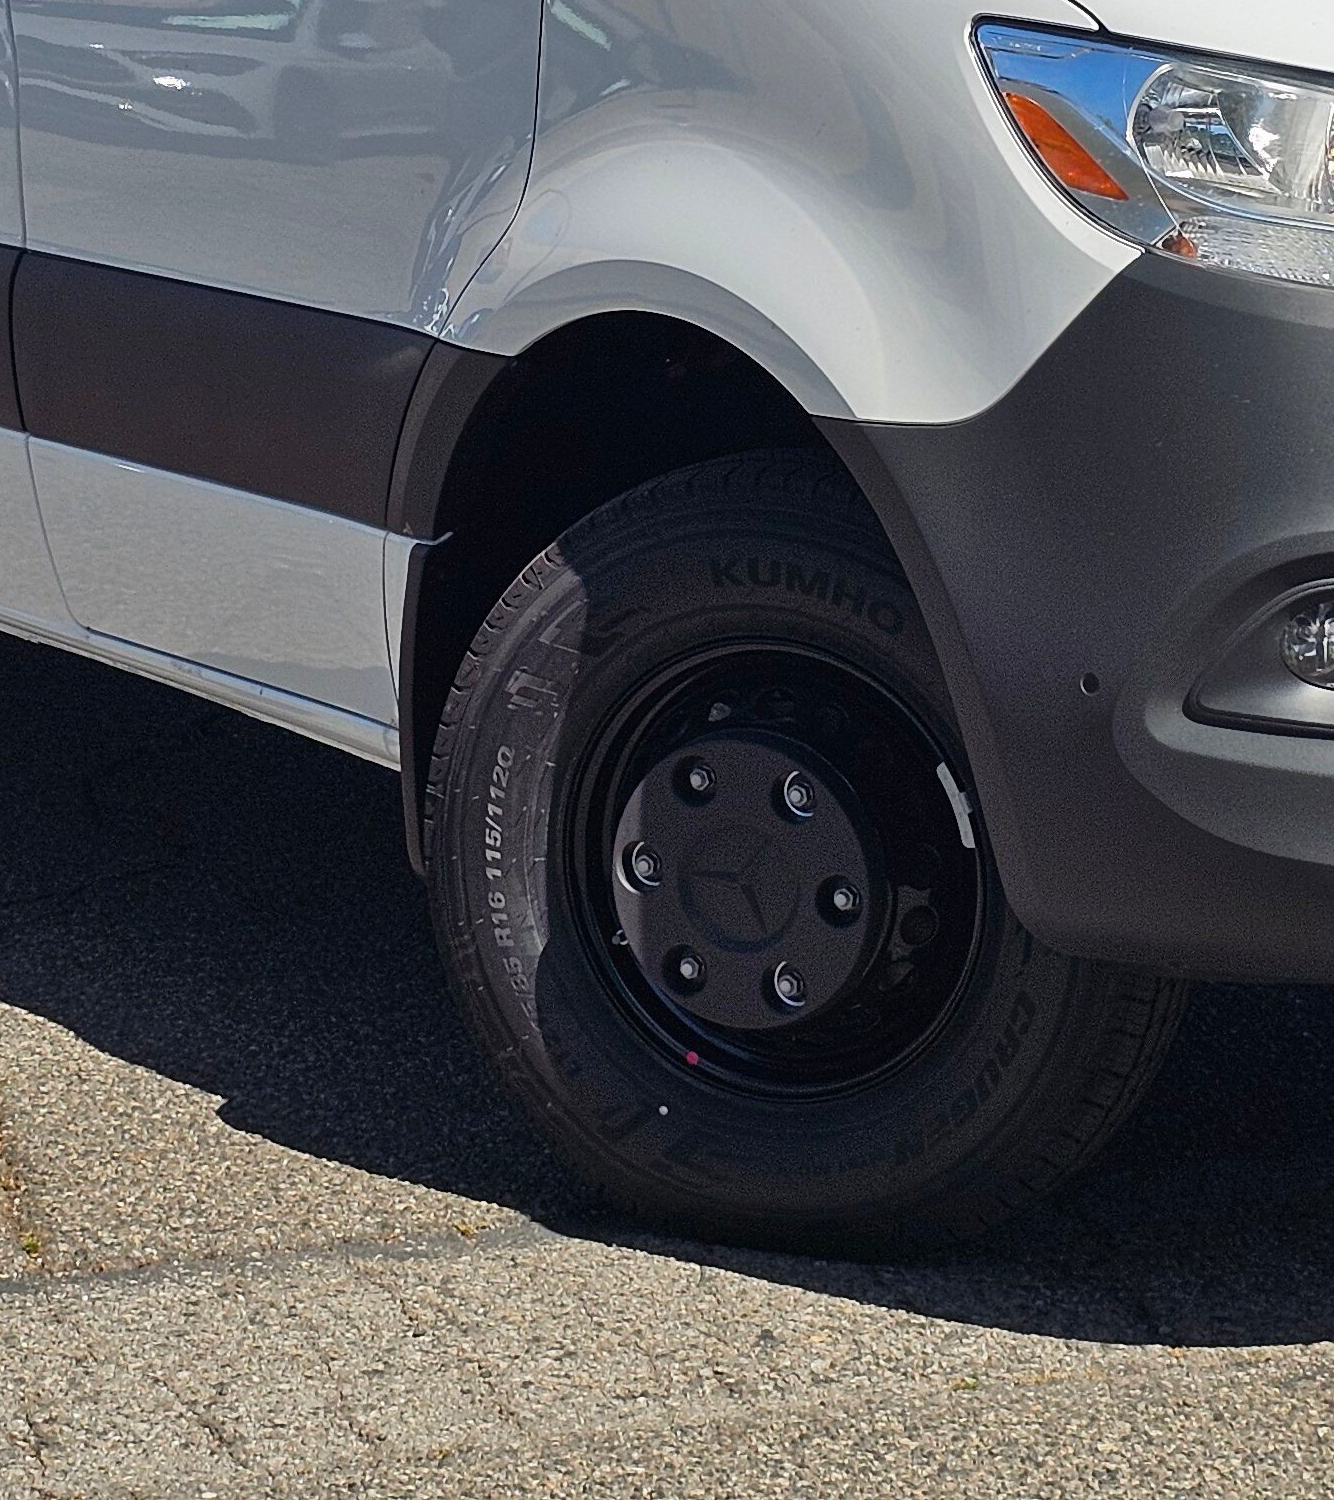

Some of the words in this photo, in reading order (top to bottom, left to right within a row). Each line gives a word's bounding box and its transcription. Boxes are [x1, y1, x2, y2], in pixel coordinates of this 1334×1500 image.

[712, 557, 904, 635] KUMHO
[484, 746, 515, 880] 115/112Q
[488, 891, 515, 948] R16
